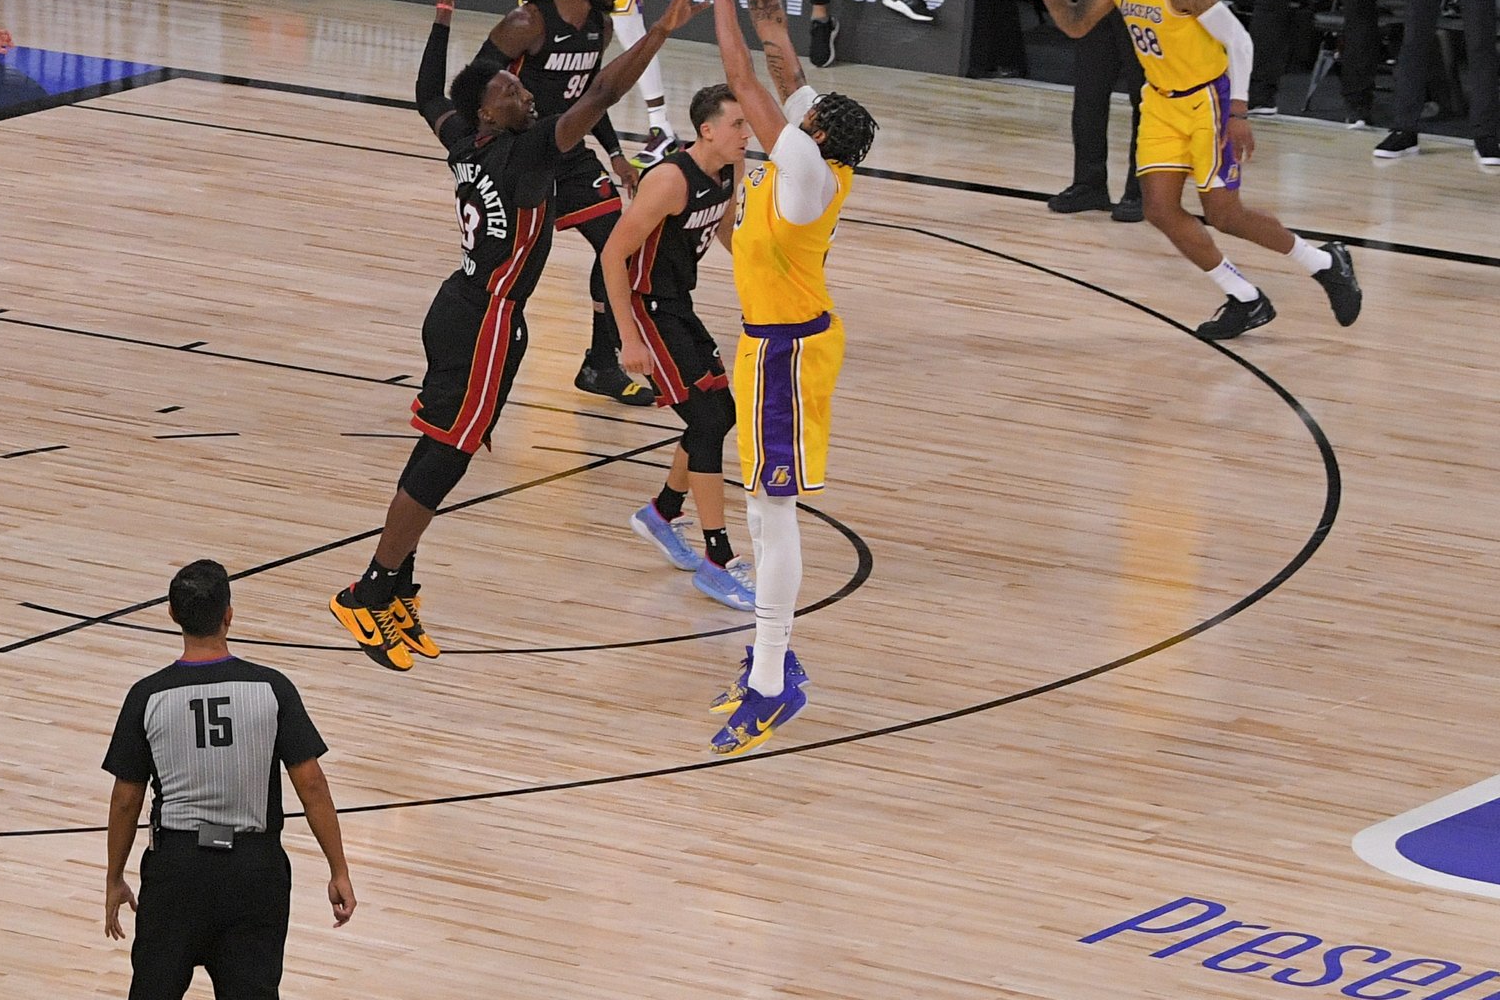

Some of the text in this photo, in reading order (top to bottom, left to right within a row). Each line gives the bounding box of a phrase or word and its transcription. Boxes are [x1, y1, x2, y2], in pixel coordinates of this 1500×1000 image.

[1129, 23, 1164, 58] 88
[476, 174, 508, 239] MATTER
[683, 199, 731, 230] MIAM
[189, 696, 234, 749] 15
